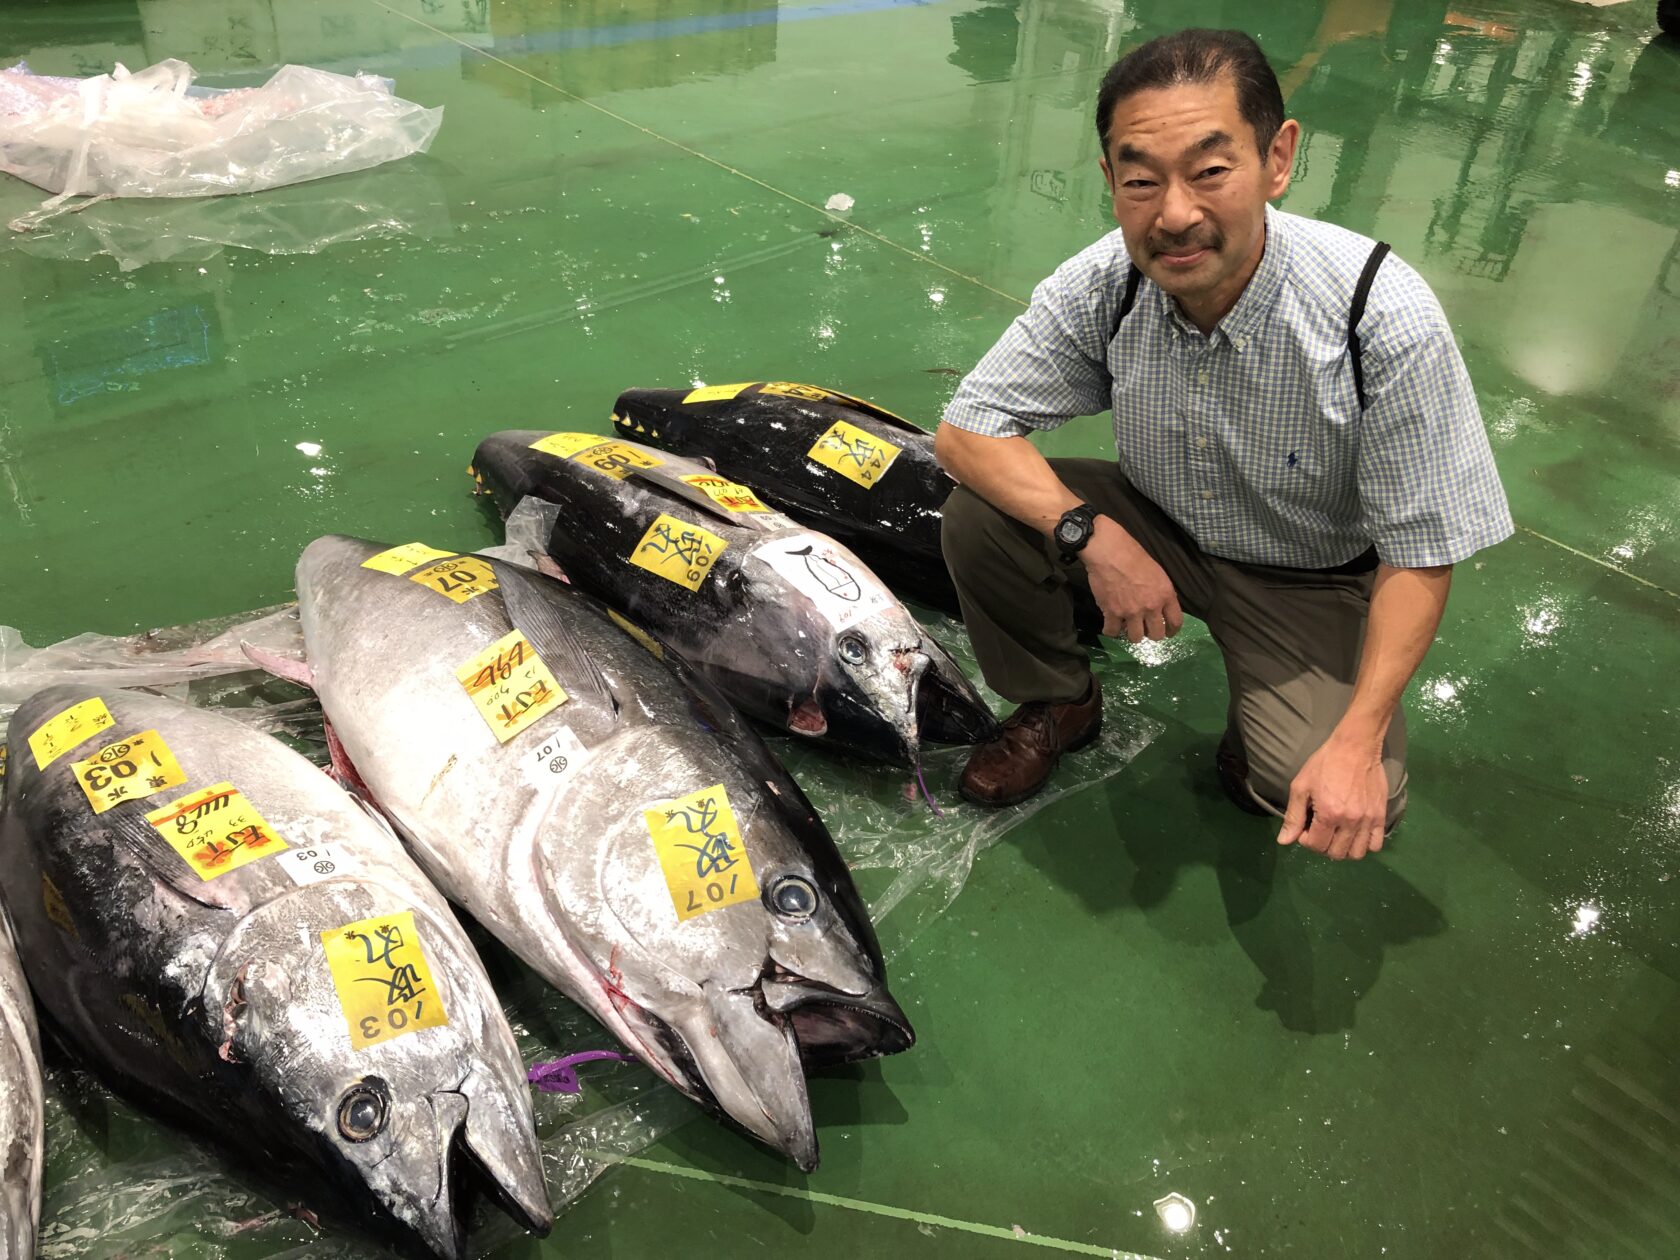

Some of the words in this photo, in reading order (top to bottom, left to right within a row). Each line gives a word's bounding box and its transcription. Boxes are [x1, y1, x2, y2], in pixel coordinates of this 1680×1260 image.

[687, 543, 712, 582] 109
[536, 737, 561, 762] 107
[84, 750, 162, 791] 103
[296, 849, 331, 861] 103
[687, 874, 738, 912] 107
[359, 1001, 423, 1039] 103
